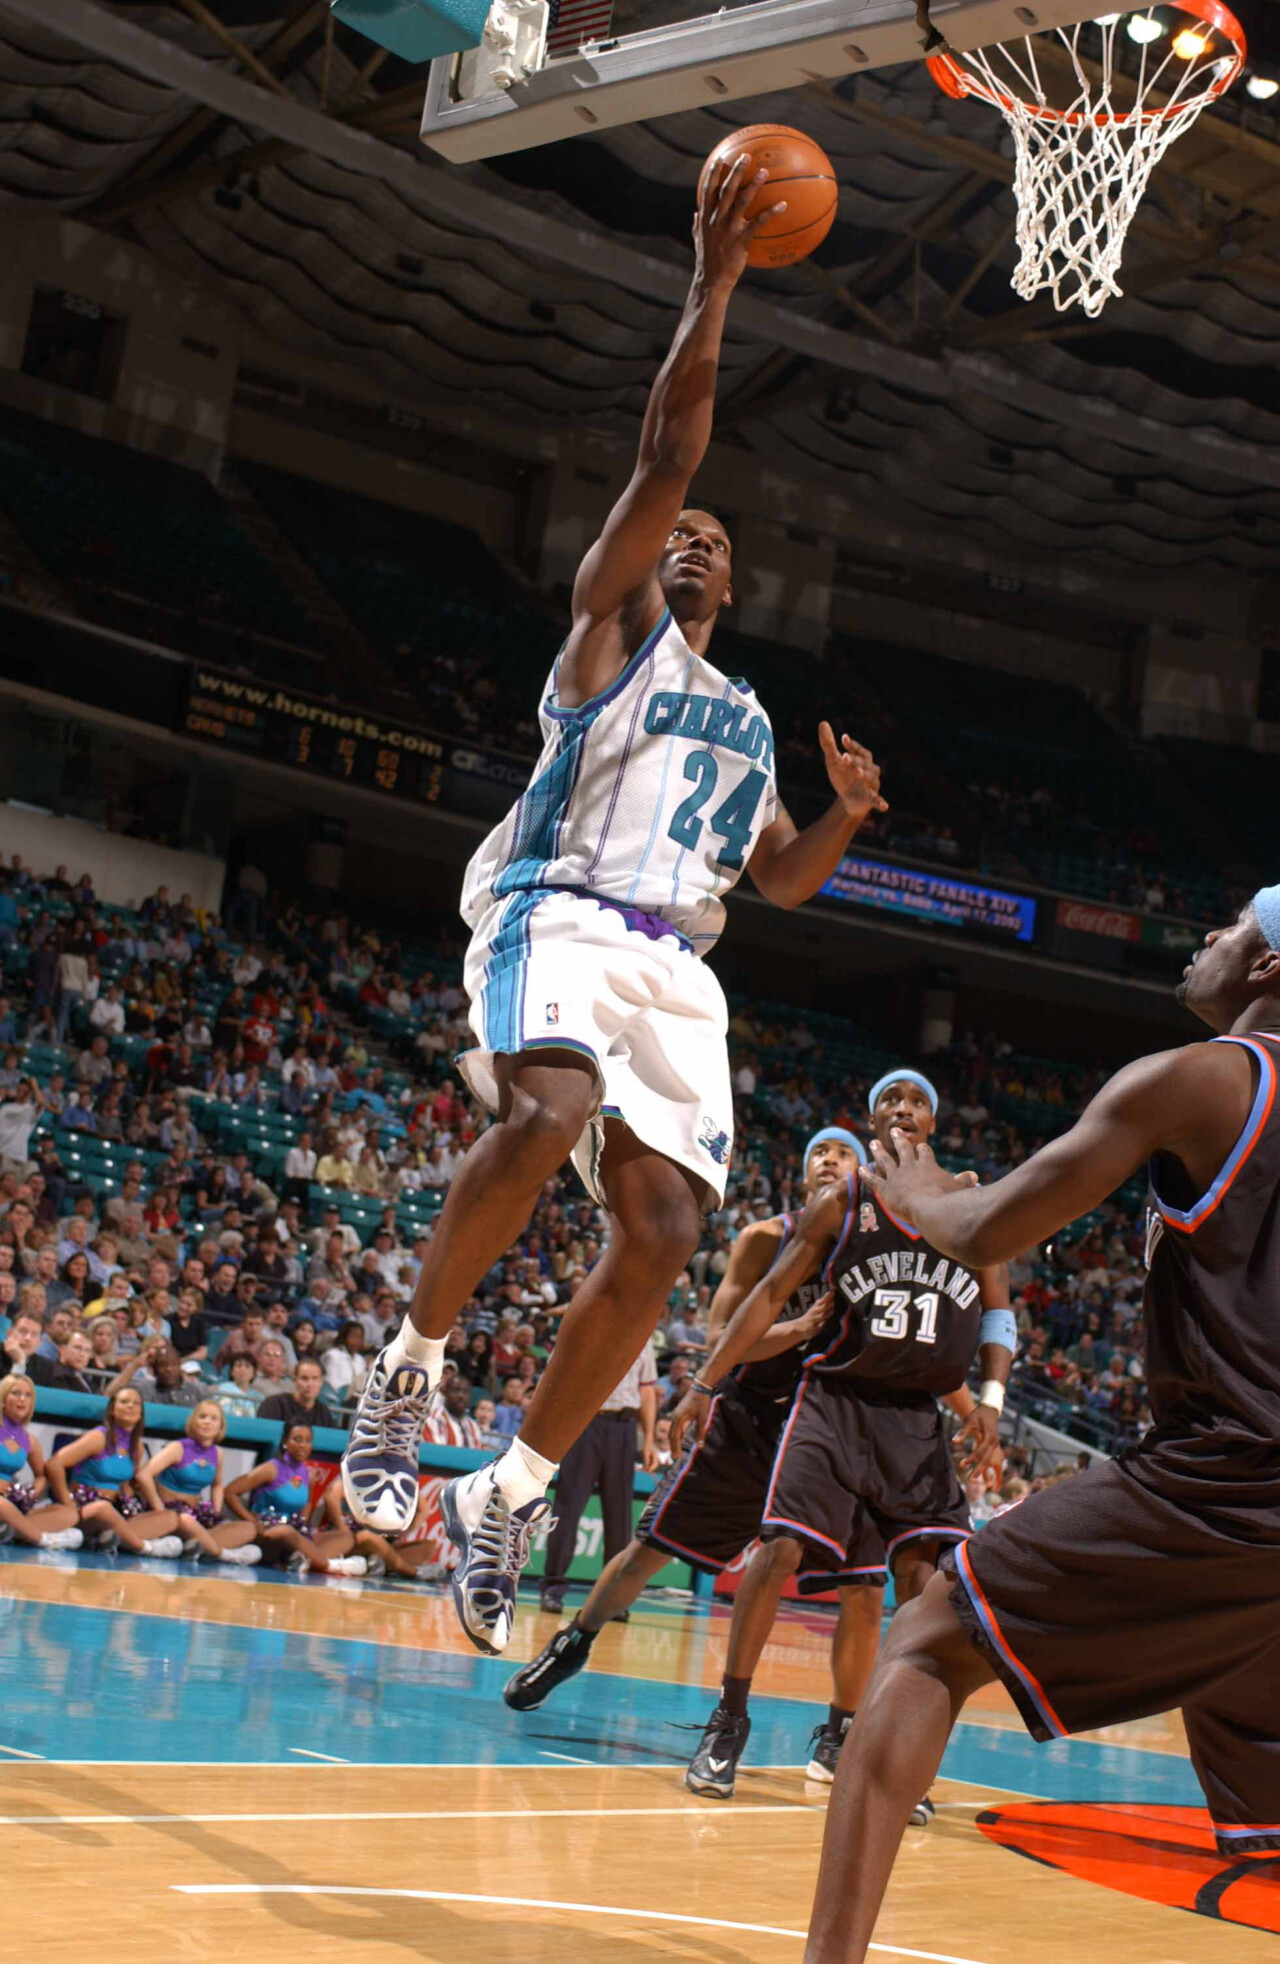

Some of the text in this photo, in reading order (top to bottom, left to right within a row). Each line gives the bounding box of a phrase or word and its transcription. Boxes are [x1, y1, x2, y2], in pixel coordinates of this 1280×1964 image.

[197, 672, 443, 759] www.hornets.com
[667, 750, 768, 872] 24
[840, 859, 926, 893] FANTASTIC
[838, 1250, 980, 1310] CLEVELAND
[870, 1288, 940, 1345] 31
